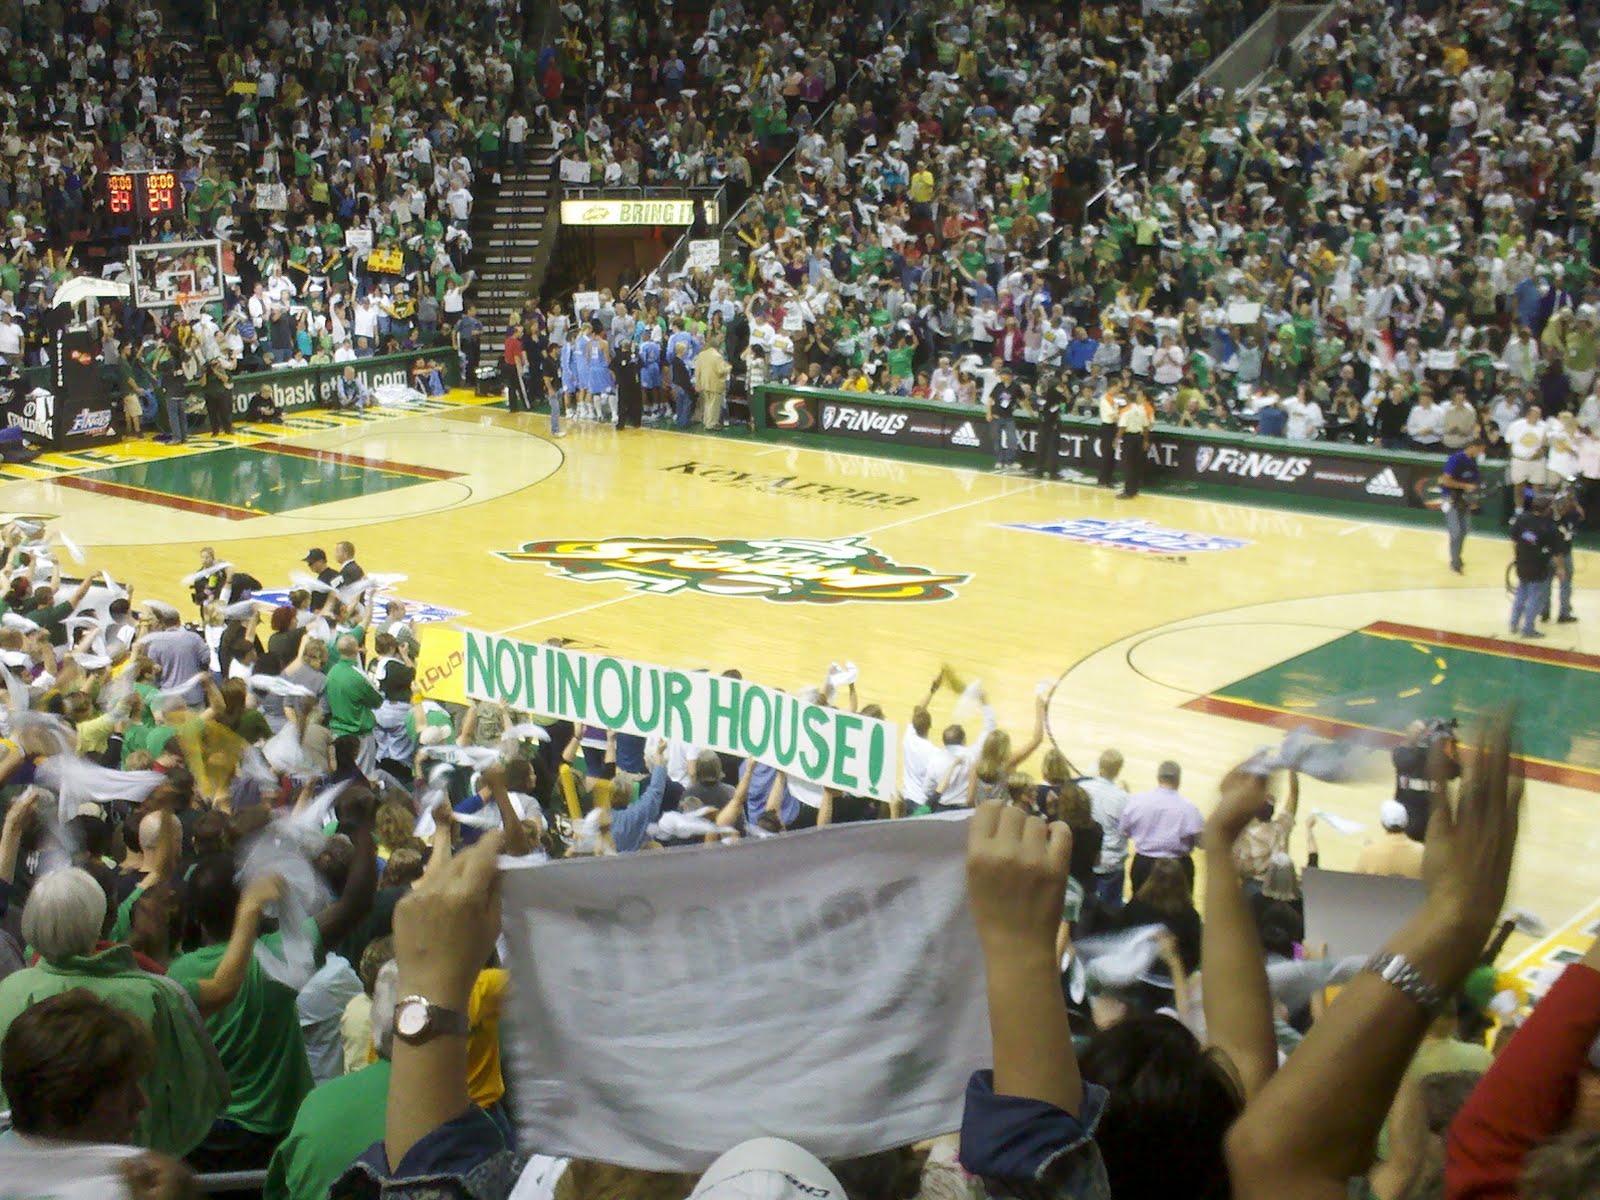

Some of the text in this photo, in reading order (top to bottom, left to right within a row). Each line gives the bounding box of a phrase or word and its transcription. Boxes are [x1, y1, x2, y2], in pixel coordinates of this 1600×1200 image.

[146, 173, 174, 189] 10:00
[149, 189, 173, 212] 24
[620, 203, 674, 223] BRING
[7, 411, 54, 440] SPALDING
[658, 460, 920, 506] KeyArena
[466, 632, 885, 795] NOT IN OUR HOUSE!
